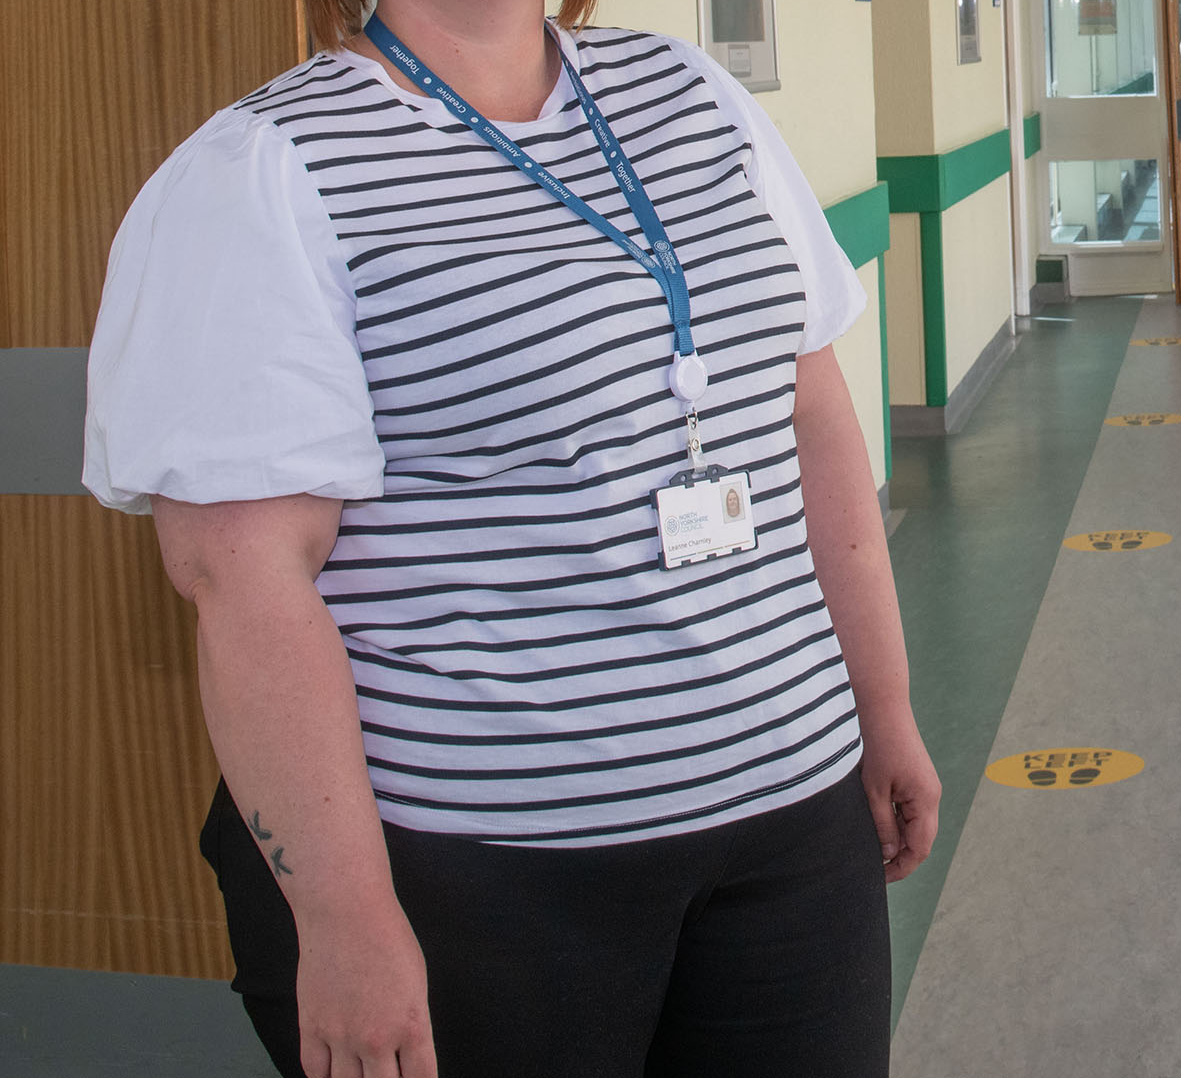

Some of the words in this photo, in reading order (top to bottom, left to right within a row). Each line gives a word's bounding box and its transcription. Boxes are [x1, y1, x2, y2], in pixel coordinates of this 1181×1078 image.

[389, 44, 421, 75] Together
[435, 86, 467, 114] Creative
[482, 125, 521, 158] Ambitious
[594, 117, 611, 149] Creative
[615, 160, 637, 194] Together
[537, 171, 571, 200] Inclusive
